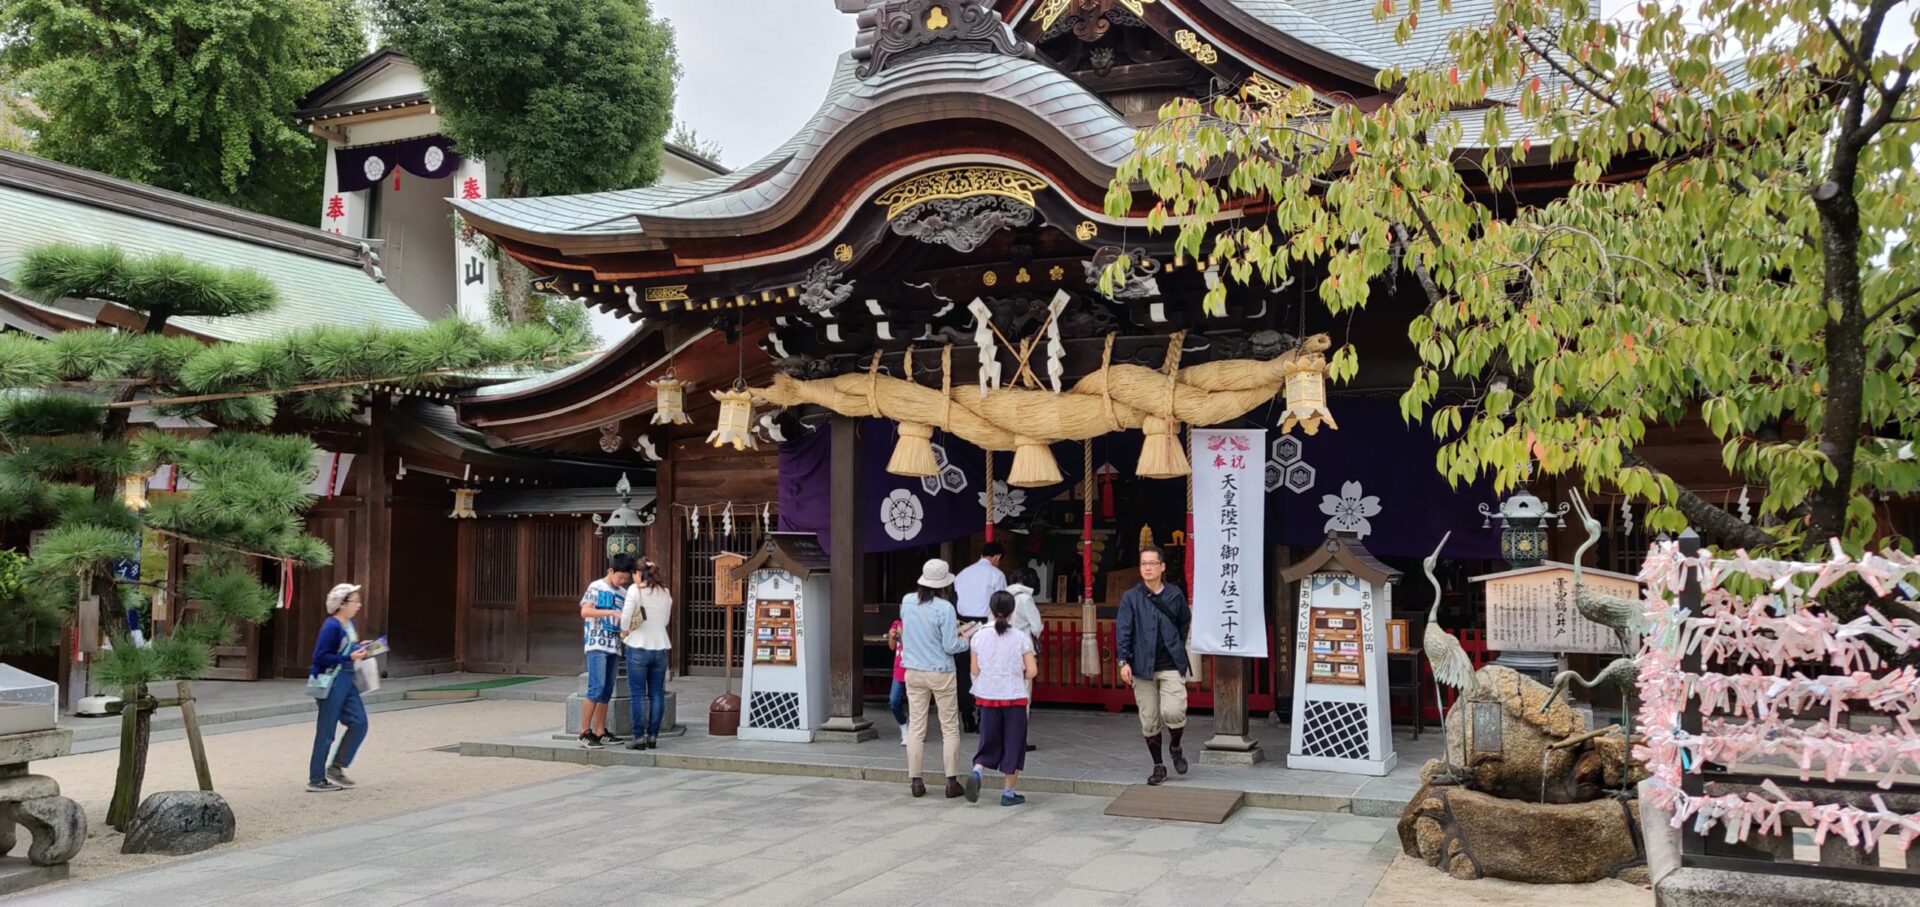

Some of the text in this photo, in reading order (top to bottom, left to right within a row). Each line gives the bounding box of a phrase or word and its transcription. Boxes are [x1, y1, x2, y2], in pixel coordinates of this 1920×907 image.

[326, 195, 345, 237] 奉
[1212, 454, 1246, 470] 奉祝
[1220, 473, 1240, 651] 天皇陛下御即位三十年
